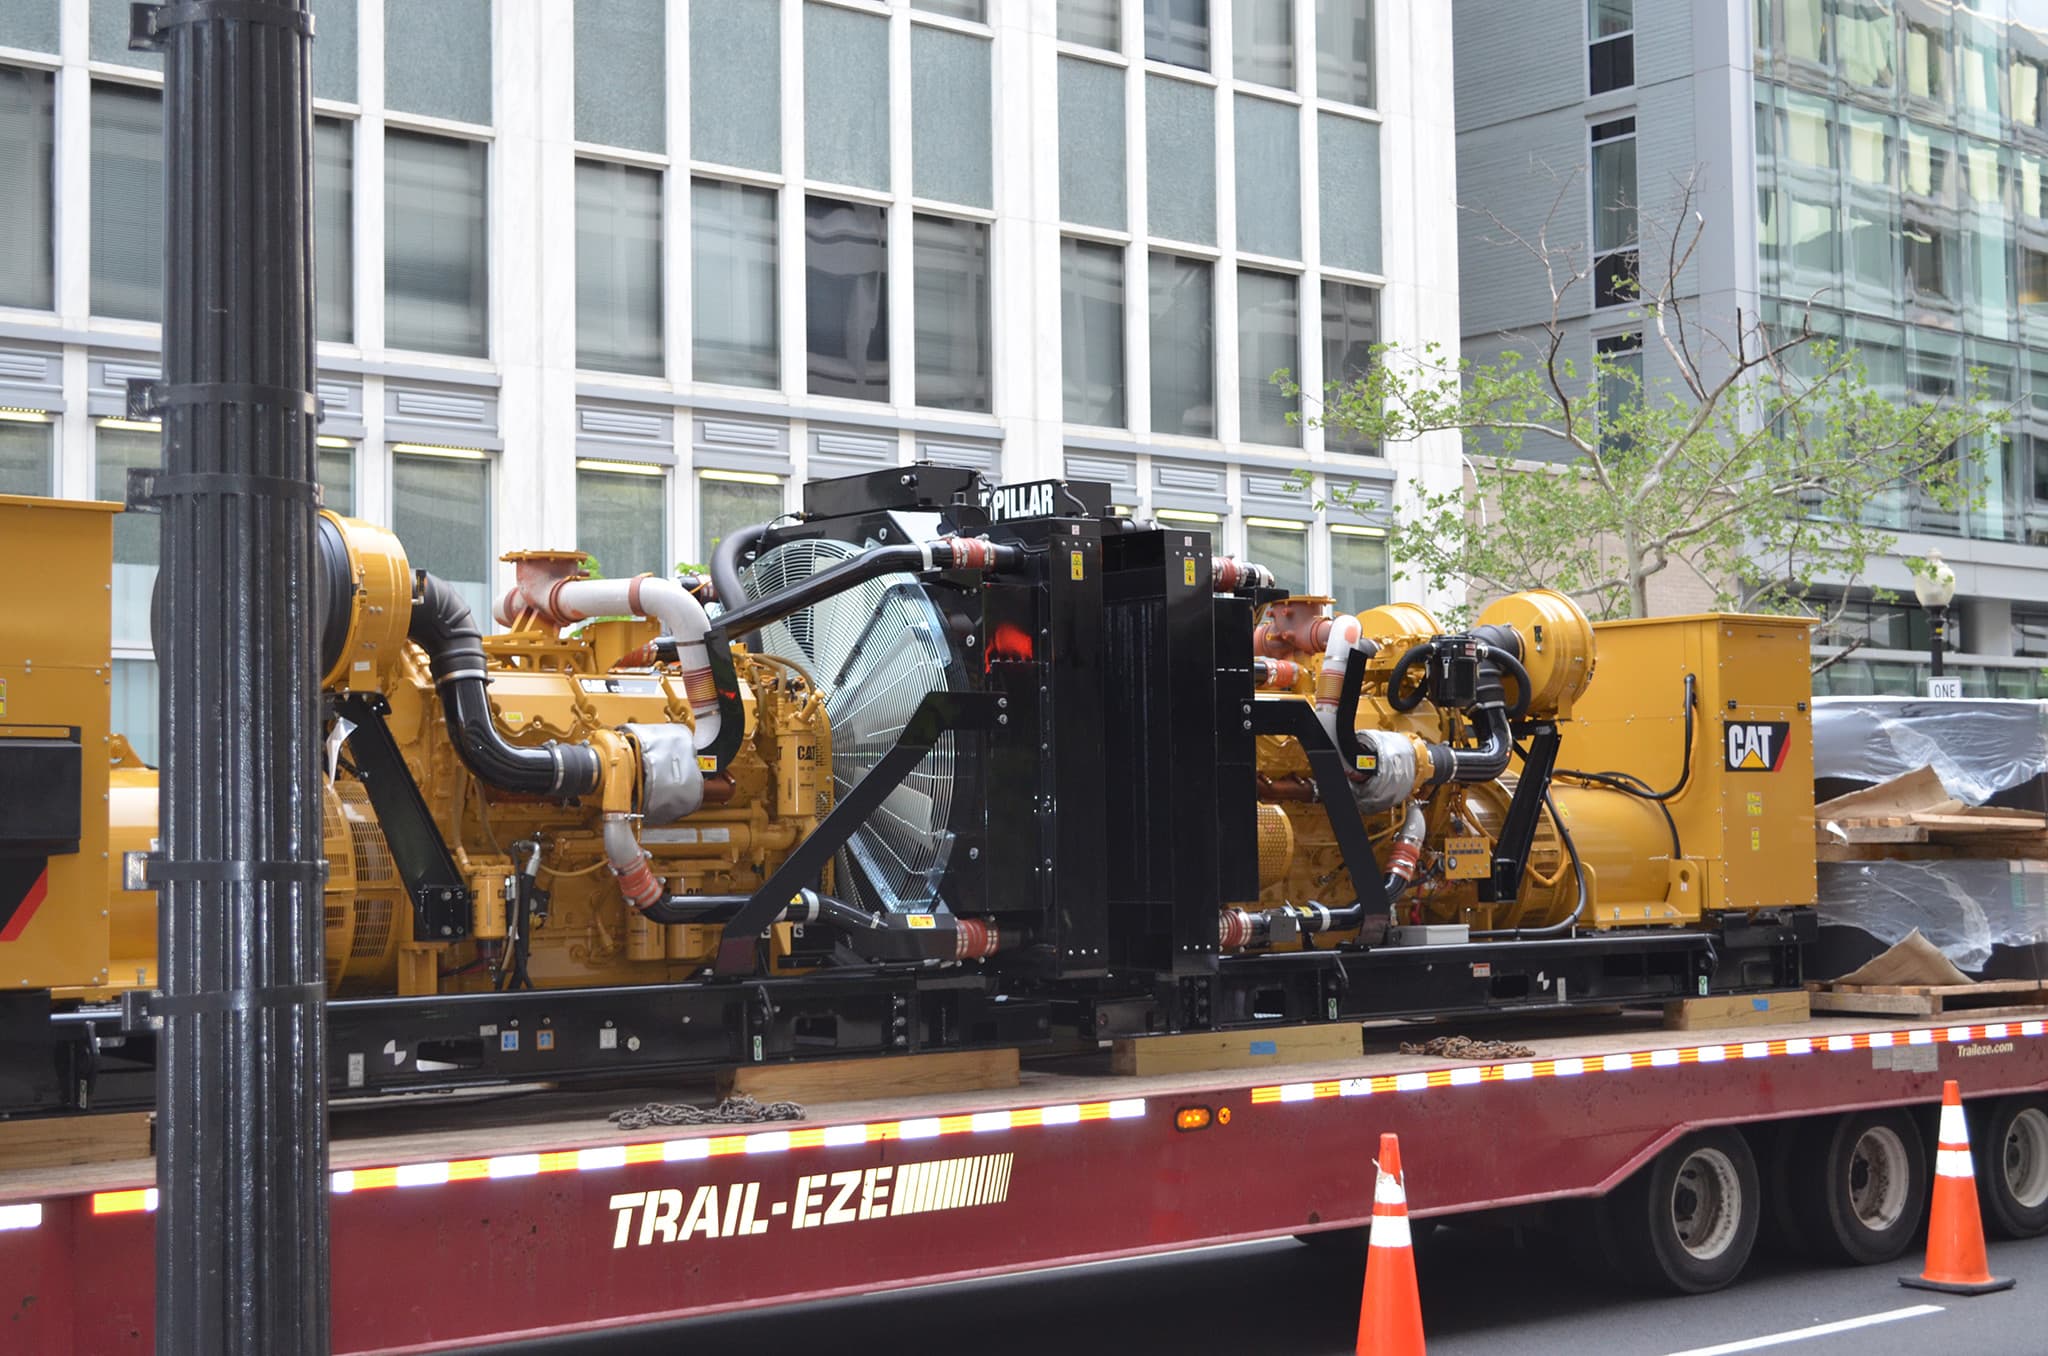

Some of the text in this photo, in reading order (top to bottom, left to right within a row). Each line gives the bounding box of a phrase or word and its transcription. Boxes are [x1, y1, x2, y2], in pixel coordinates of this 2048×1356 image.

[1935, 684, 1956, 698] ONE
[1728, 724, 1772, 768] CAT
[1957, 1042, 2014, 1057] Traileze.com
[609, 1166, 894, 1249] TRAIL-EZE
